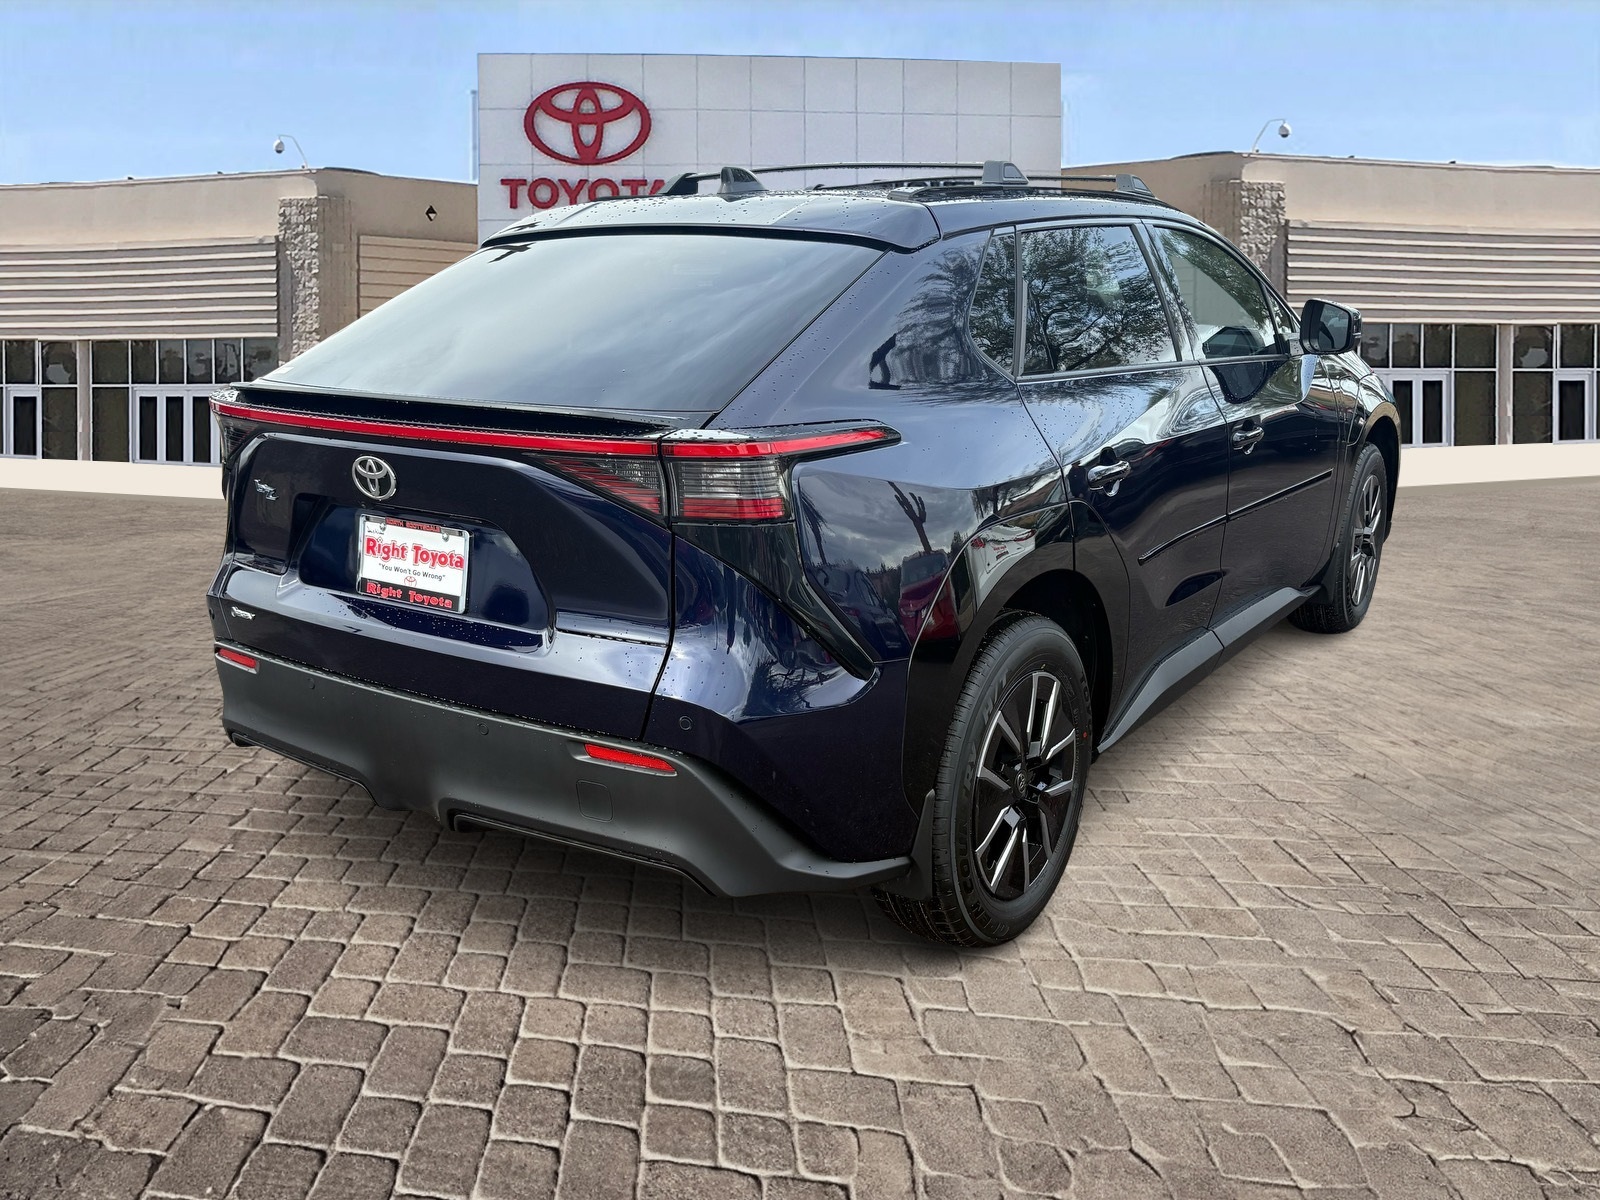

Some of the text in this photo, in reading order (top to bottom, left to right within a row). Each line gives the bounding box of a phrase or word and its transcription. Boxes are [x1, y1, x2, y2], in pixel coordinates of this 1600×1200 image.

[365, 536, 464, 569] Right Toyota
[379, 563, 446, 582] "You Won't Go Wrong"
[366, 581, 452, 609] Right Toyota
